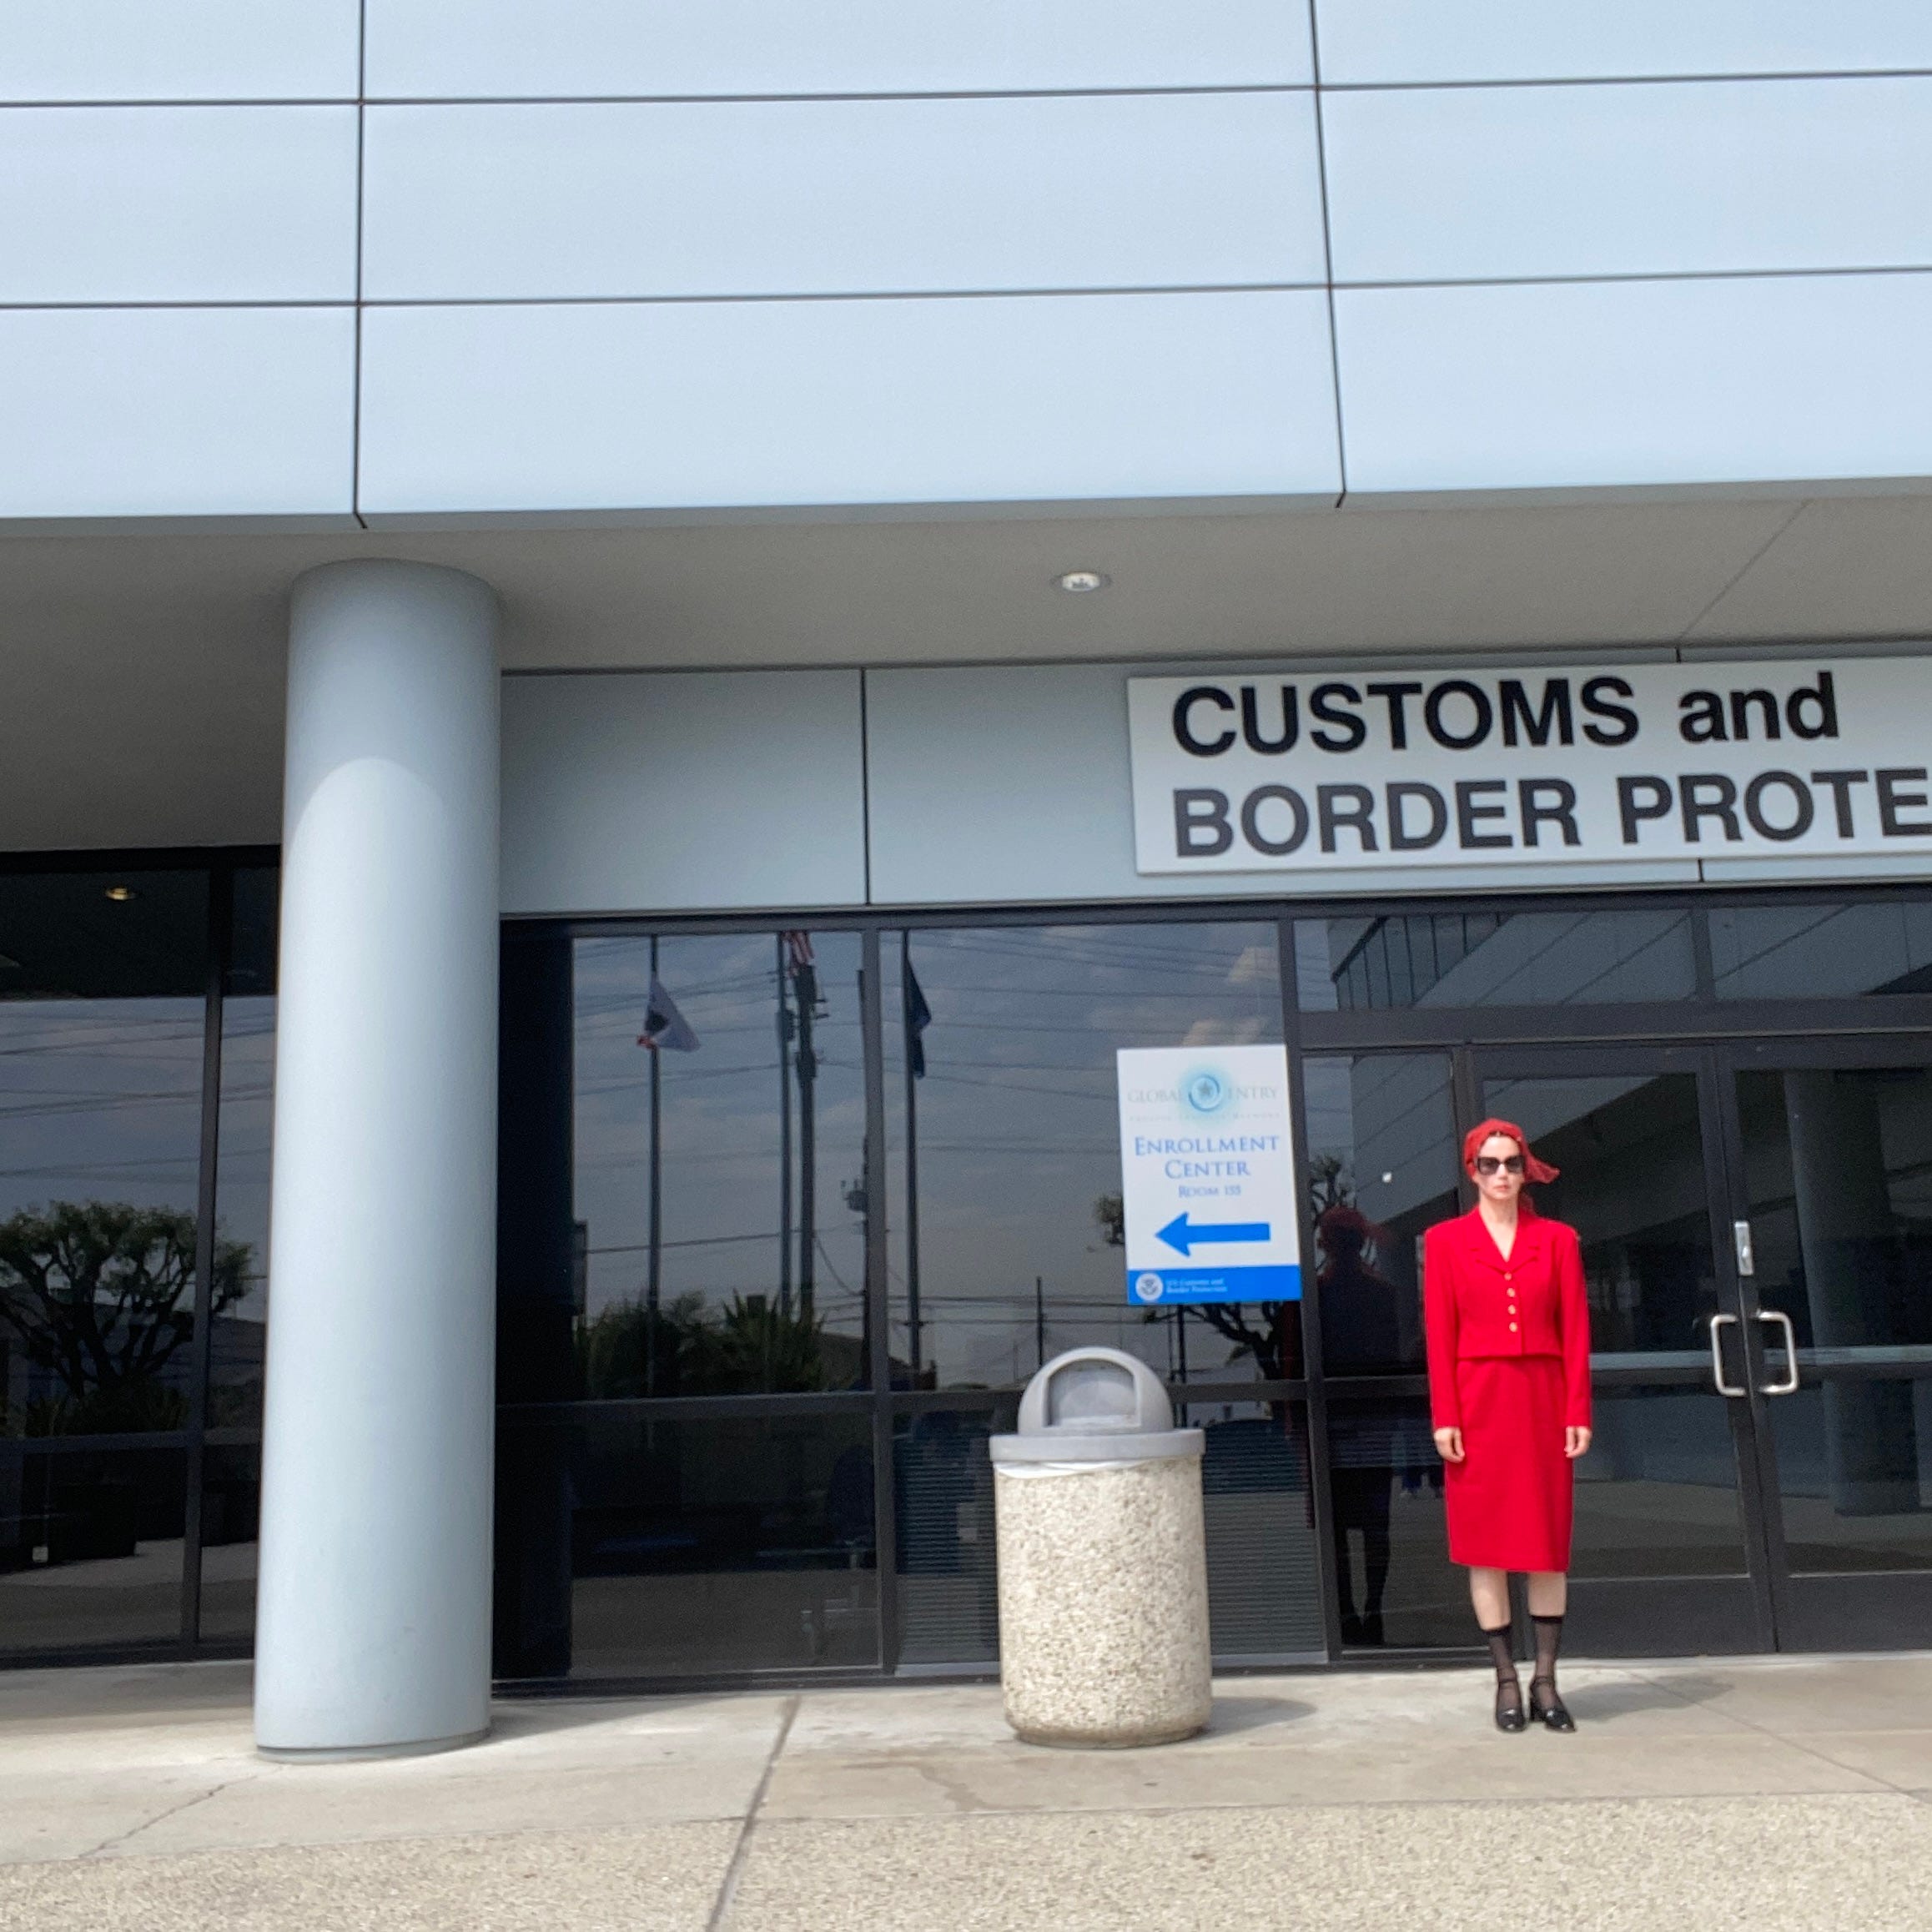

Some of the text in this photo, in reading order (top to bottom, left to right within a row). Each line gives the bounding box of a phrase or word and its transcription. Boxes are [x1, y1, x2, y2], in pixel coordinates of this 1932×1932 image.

[1172, 670, 1839, 757] CUSTOMS and
[1173, 767, 1932, 857] BORDER PROTE
